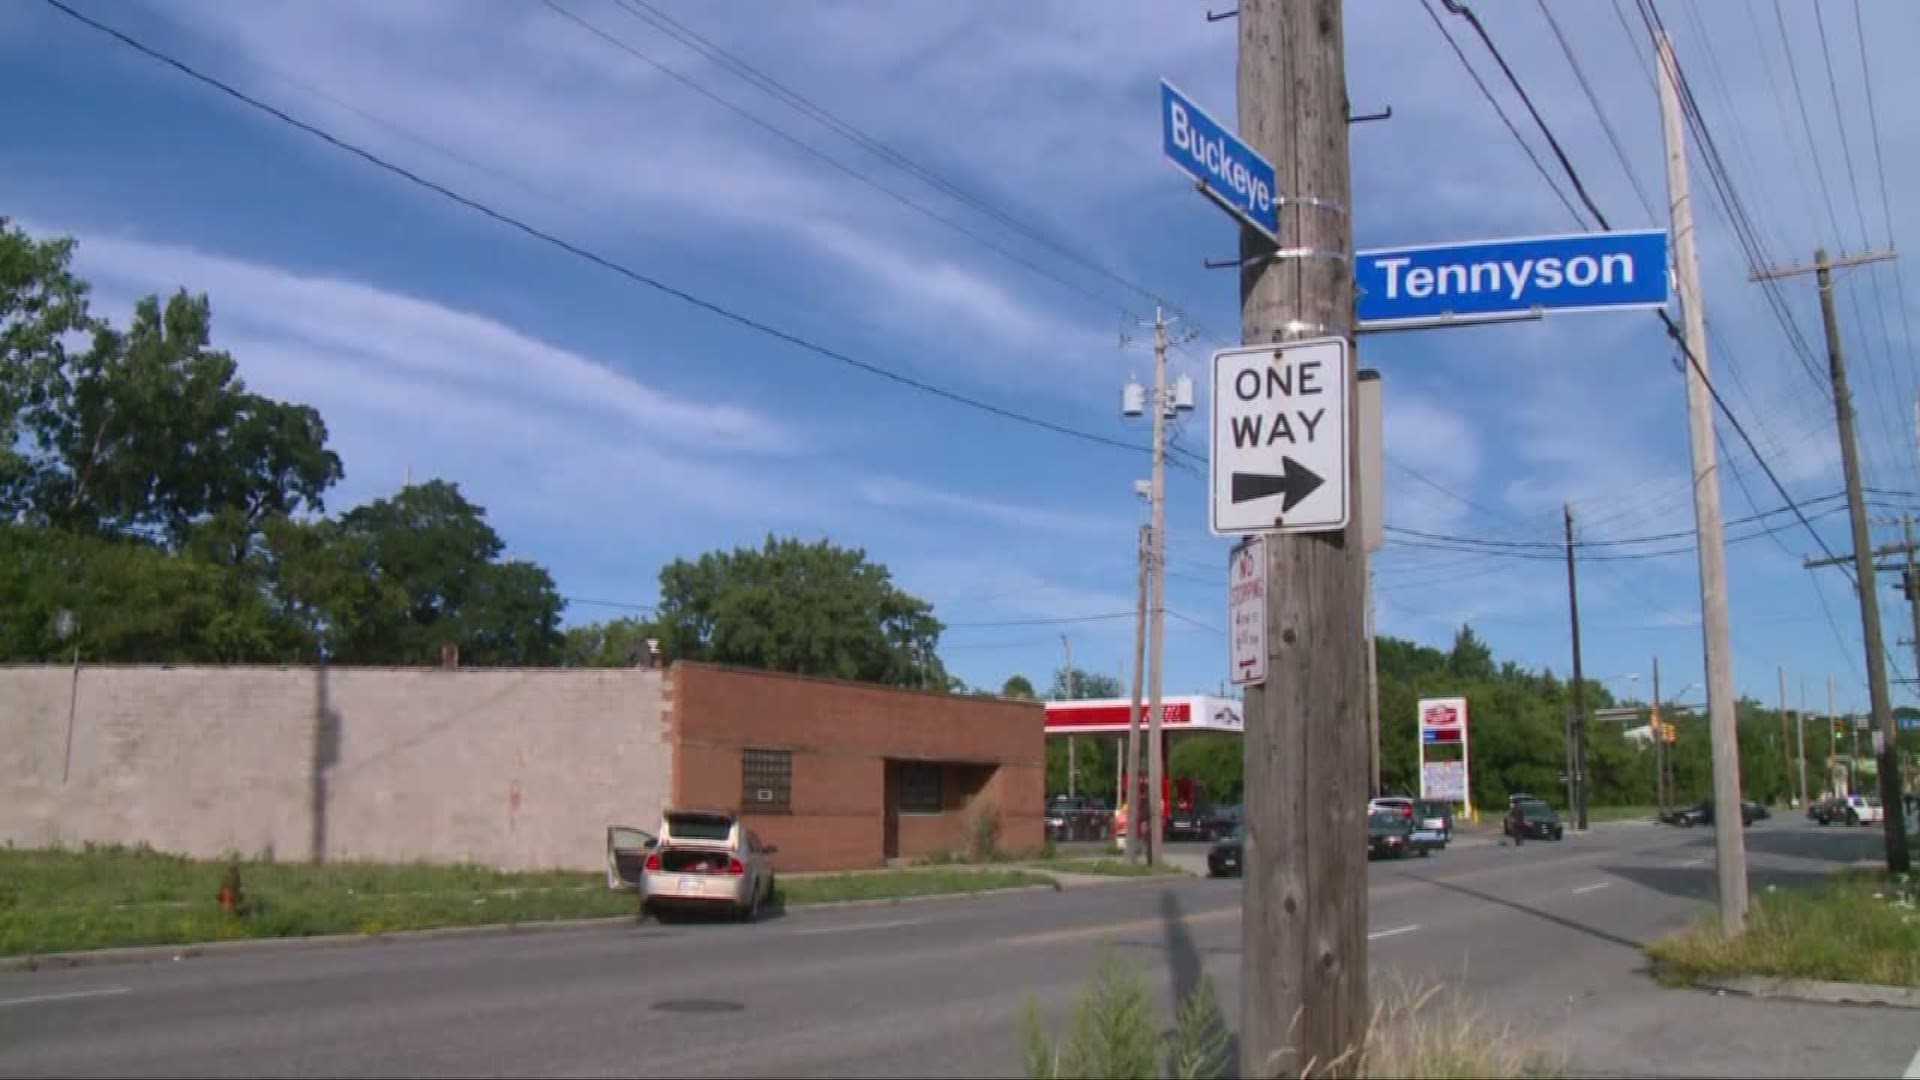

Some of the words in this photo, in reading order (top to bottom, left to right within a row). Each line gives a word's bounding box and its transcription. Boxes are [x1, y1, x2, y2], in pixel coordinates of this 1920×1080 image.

[1171, 101, 1270, 213] Buckeye
[1375, 253, 1634, 300] Tennyson
[1235, 361, 1322, 401] ONE
[1231, 408, 1326, 449] WAY
